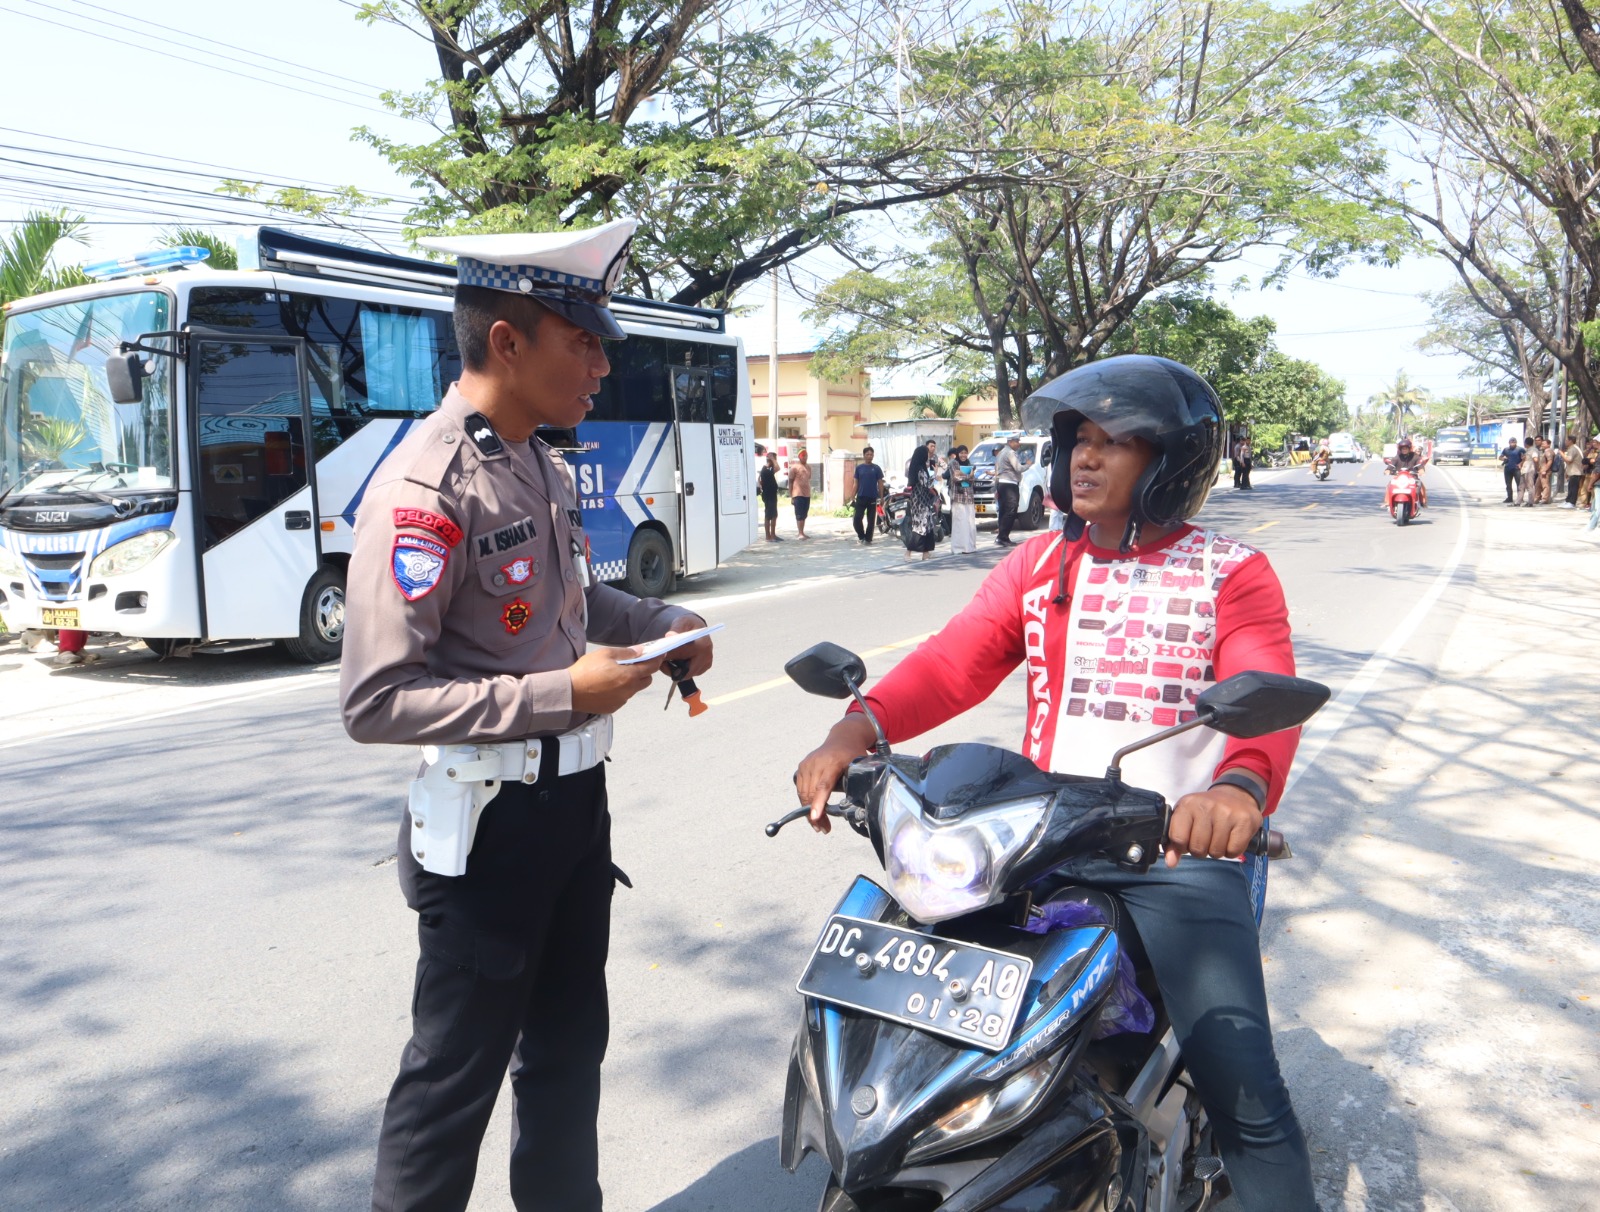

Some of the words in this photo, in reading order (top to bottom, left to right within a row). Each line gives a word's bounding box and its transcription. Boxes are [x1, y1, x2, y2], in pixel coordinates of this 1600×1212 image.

[579, 441, 600, 450] AYANI
[581, 498, 605, 510] TAS
[35, 511, 70, 523] ISUZU
[397, 511, 461, 545] PELOPOR
[28, 536, 75, 552] POLISI
[1133, 568, 1161, 580] Start
[1160, 570, 1205, 592] Engin
[1154, 643, 1213, 661] HON
[1074, 655, 1097, 667] Start
[1096, 656, 1149, 677] Engine!
[819, 922, 862, 957] DC
[874, 936, 957, 982] 4894
[1071, 952, 1111, 1010] MX
